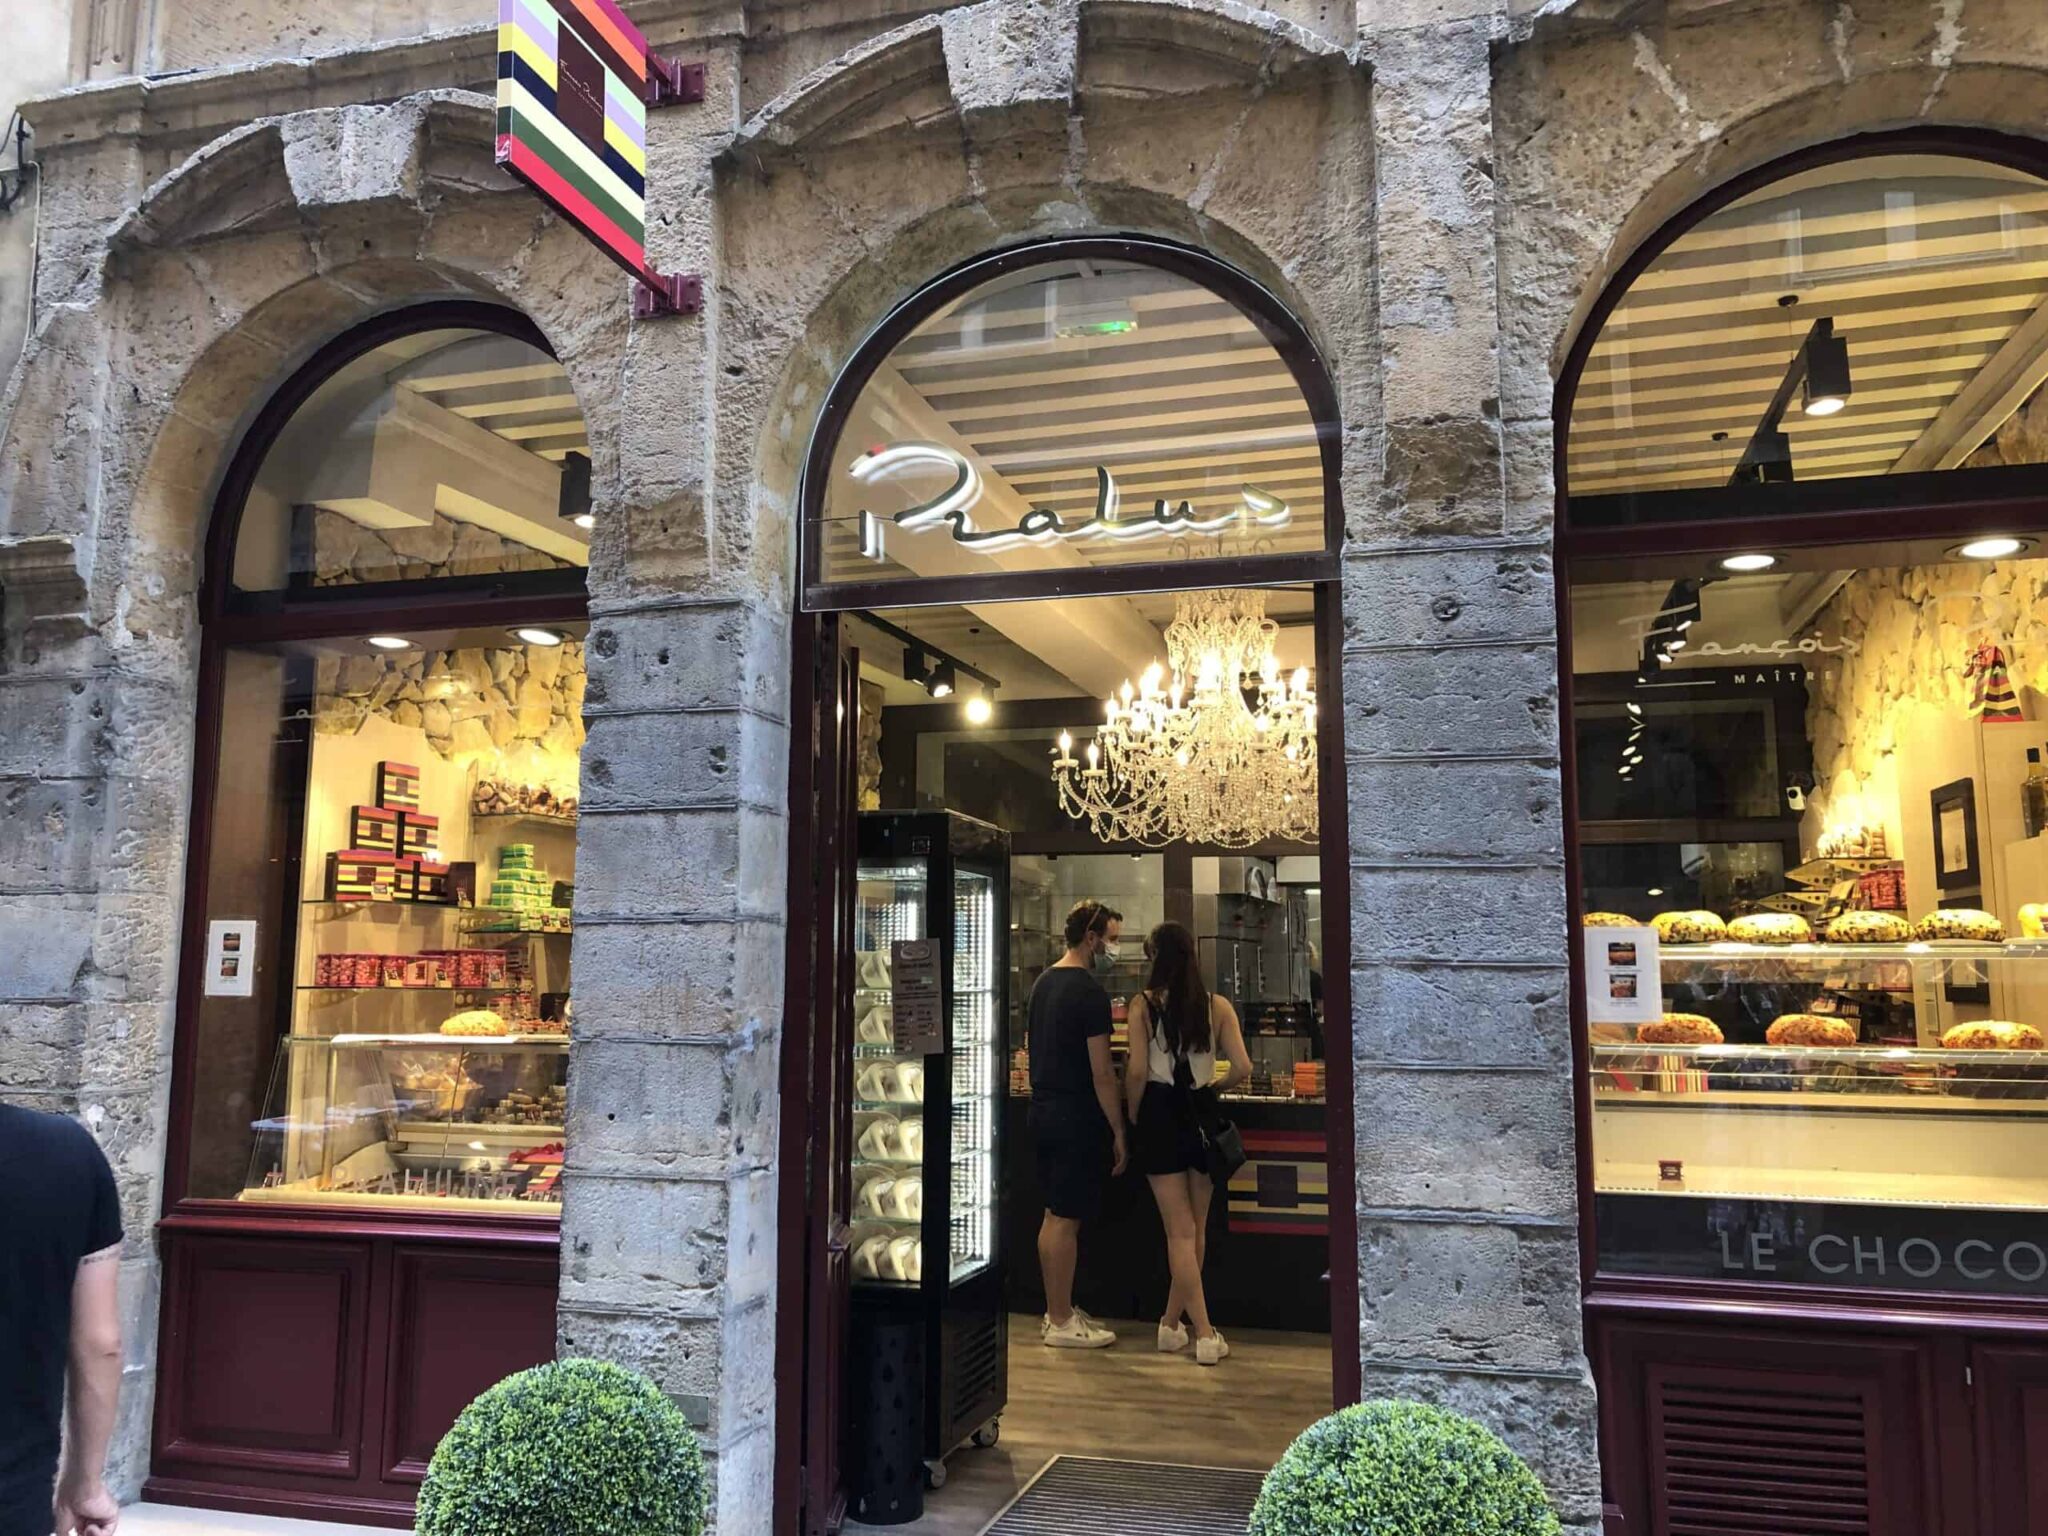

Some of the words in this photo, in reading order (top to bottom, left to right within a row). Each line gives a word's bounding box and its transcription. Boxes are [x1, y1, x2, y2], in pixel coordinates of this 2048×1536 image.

[849, 441, 1293, 563] Pralus
[1734, 669, 1833, 684] MAÎTRE
[1717, 1230, 1776, 1271] LE
[1808, 1234, 2047, 1282] CHOCO
